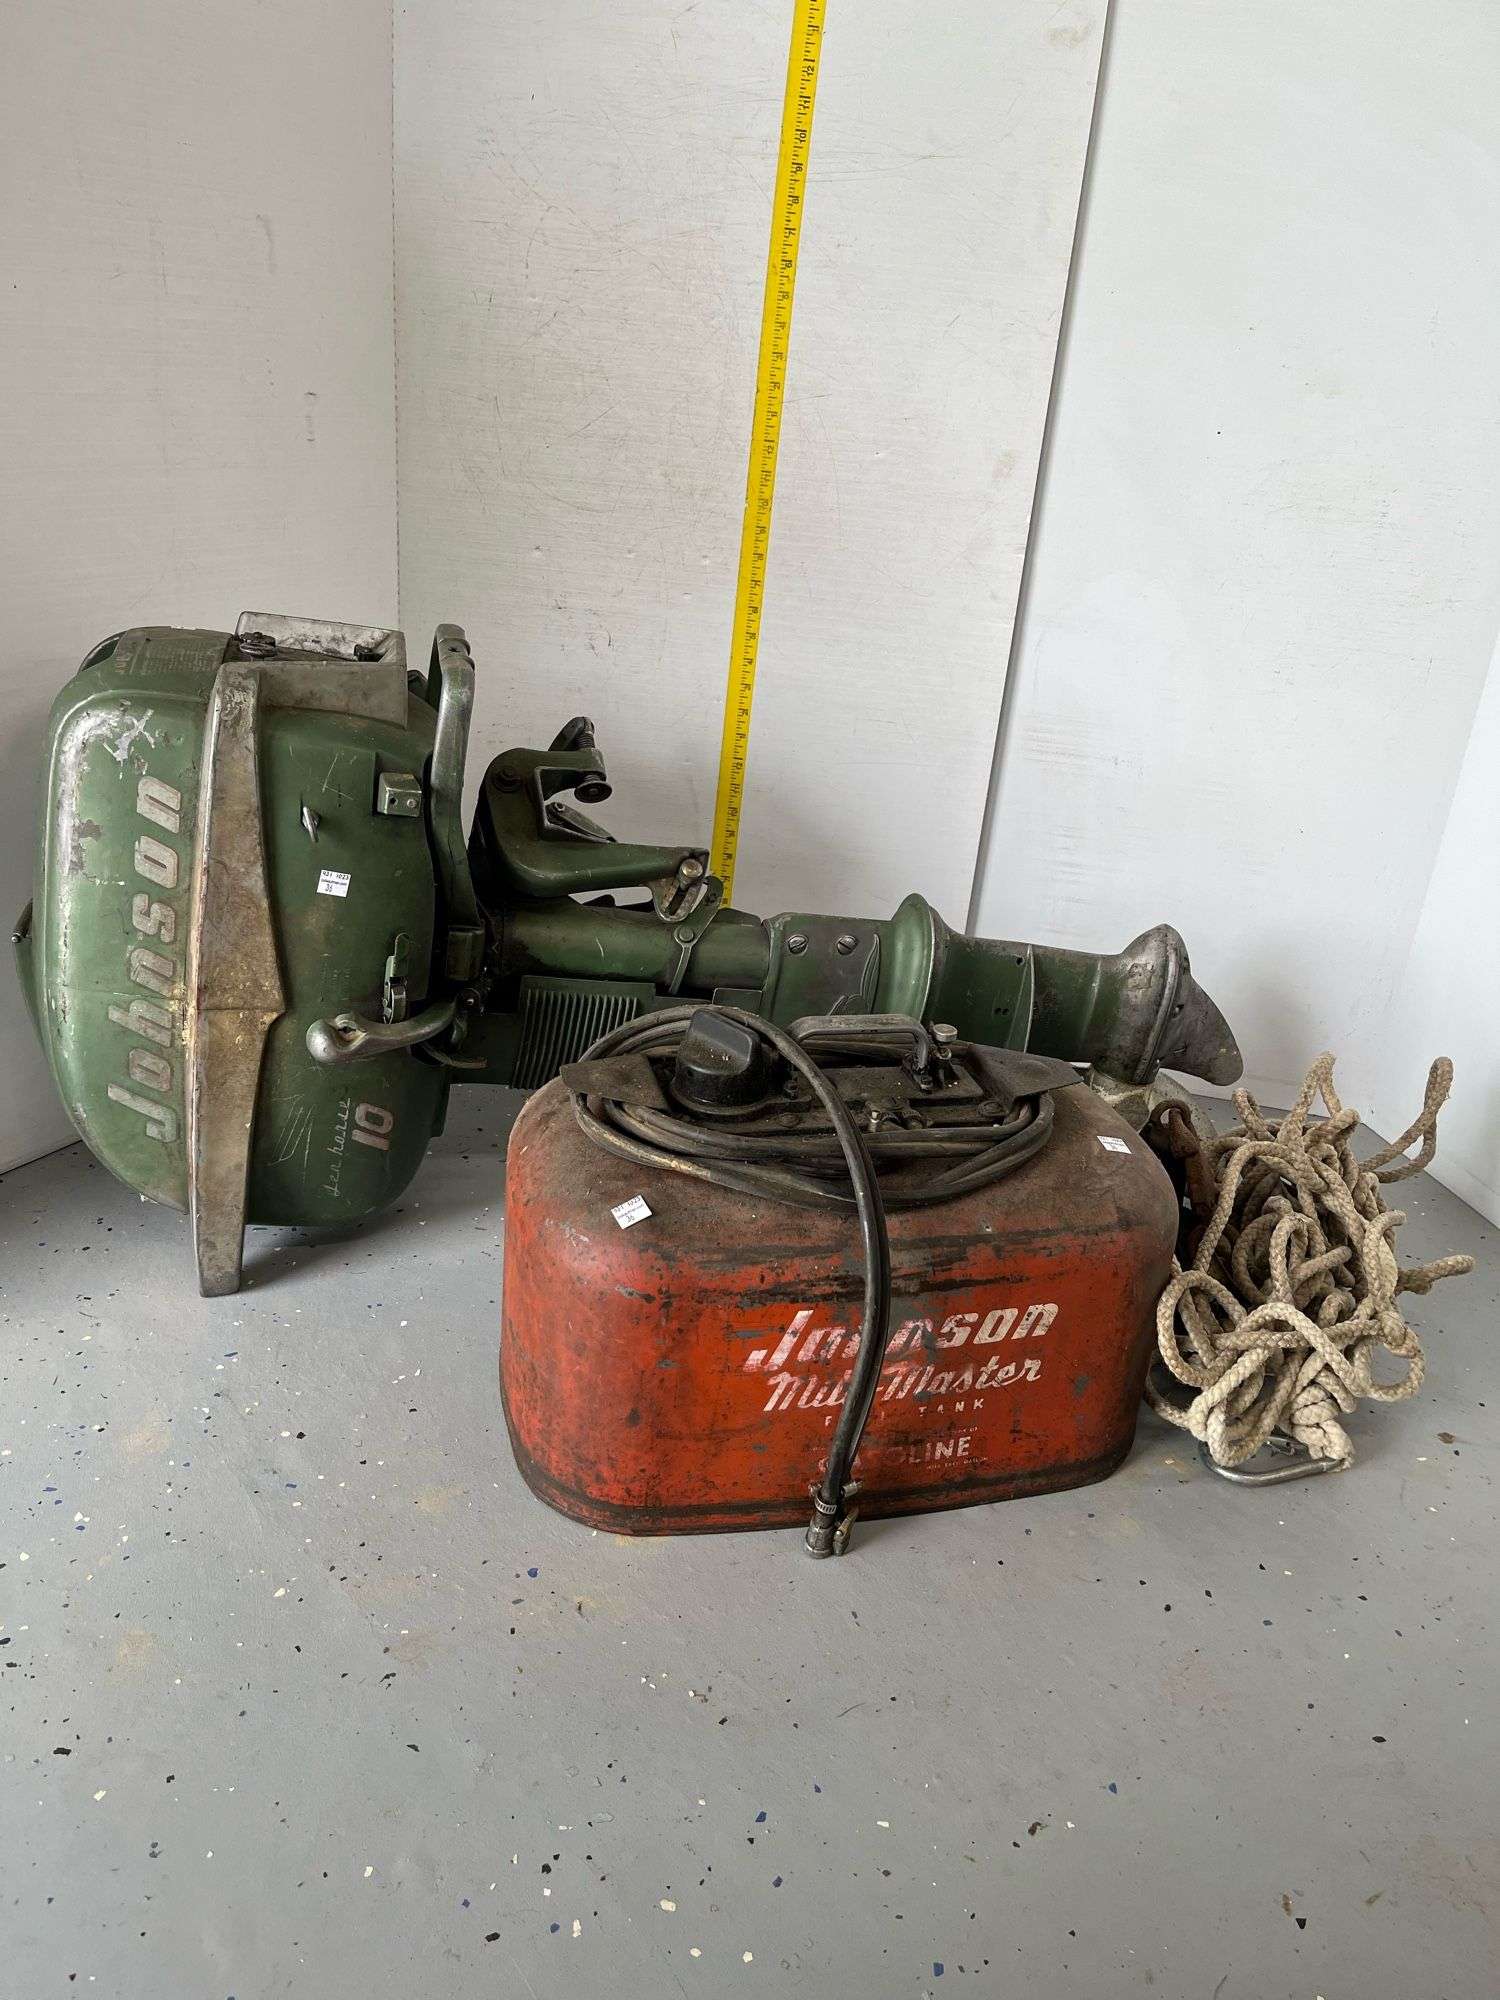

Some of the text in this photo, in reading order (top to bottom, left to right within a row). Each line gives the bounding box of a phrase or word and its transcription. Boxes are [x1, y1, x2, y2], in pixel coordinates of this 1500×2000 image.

[806, 65, 815, 76] 12
[799, 132, 807, 144] 10
[107, 775, 181, 1143] Johnson
[352, 1102, 393, 1151] 10
[763, 1355, 1042, 1412] Mil-Master
[918, 1398, 985, 1416] TANK
